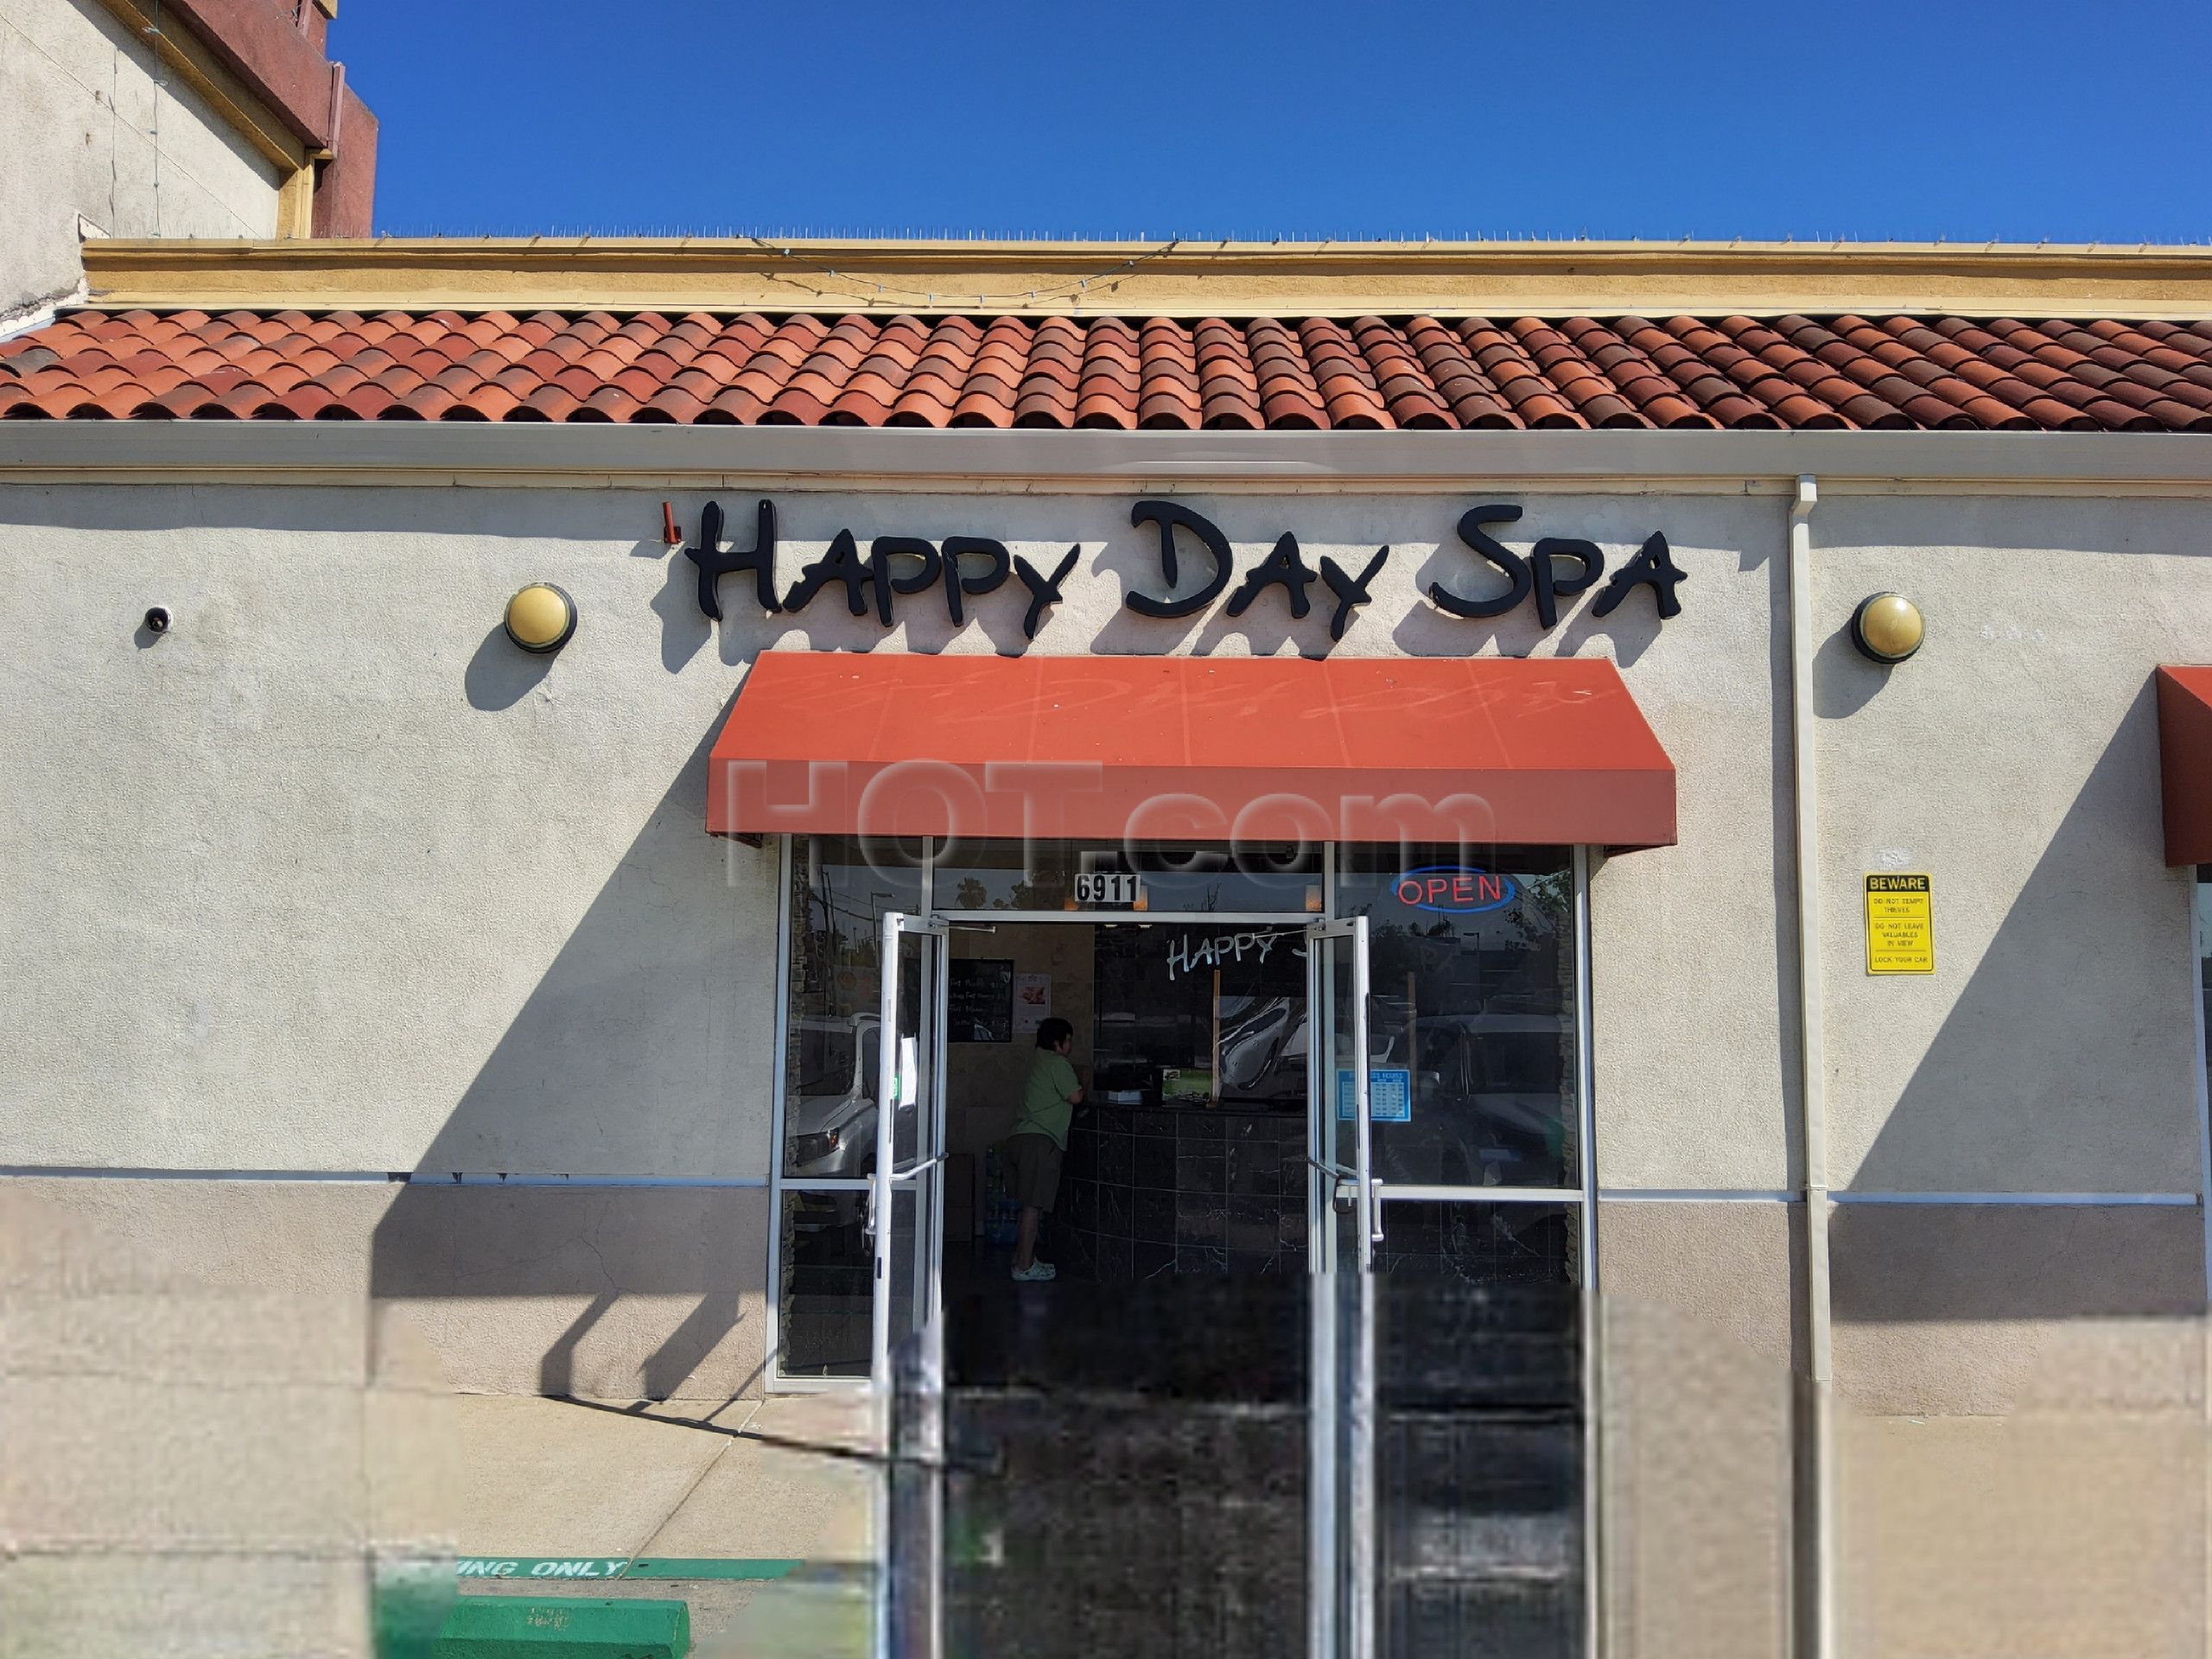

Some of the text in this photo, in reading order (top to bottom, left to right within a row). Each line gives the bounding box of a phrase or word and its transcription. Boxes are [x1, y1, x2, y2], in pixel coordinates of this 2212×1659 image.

[1077, 874, 1138, 900] 6911
[1398, 875, 1502, 905] OPEN
[1870, 877, 1926, 890] BEWARE
[1166, 933, 1278, 981] HAPPY
[531, 1561, 627, 1576] ONLY
